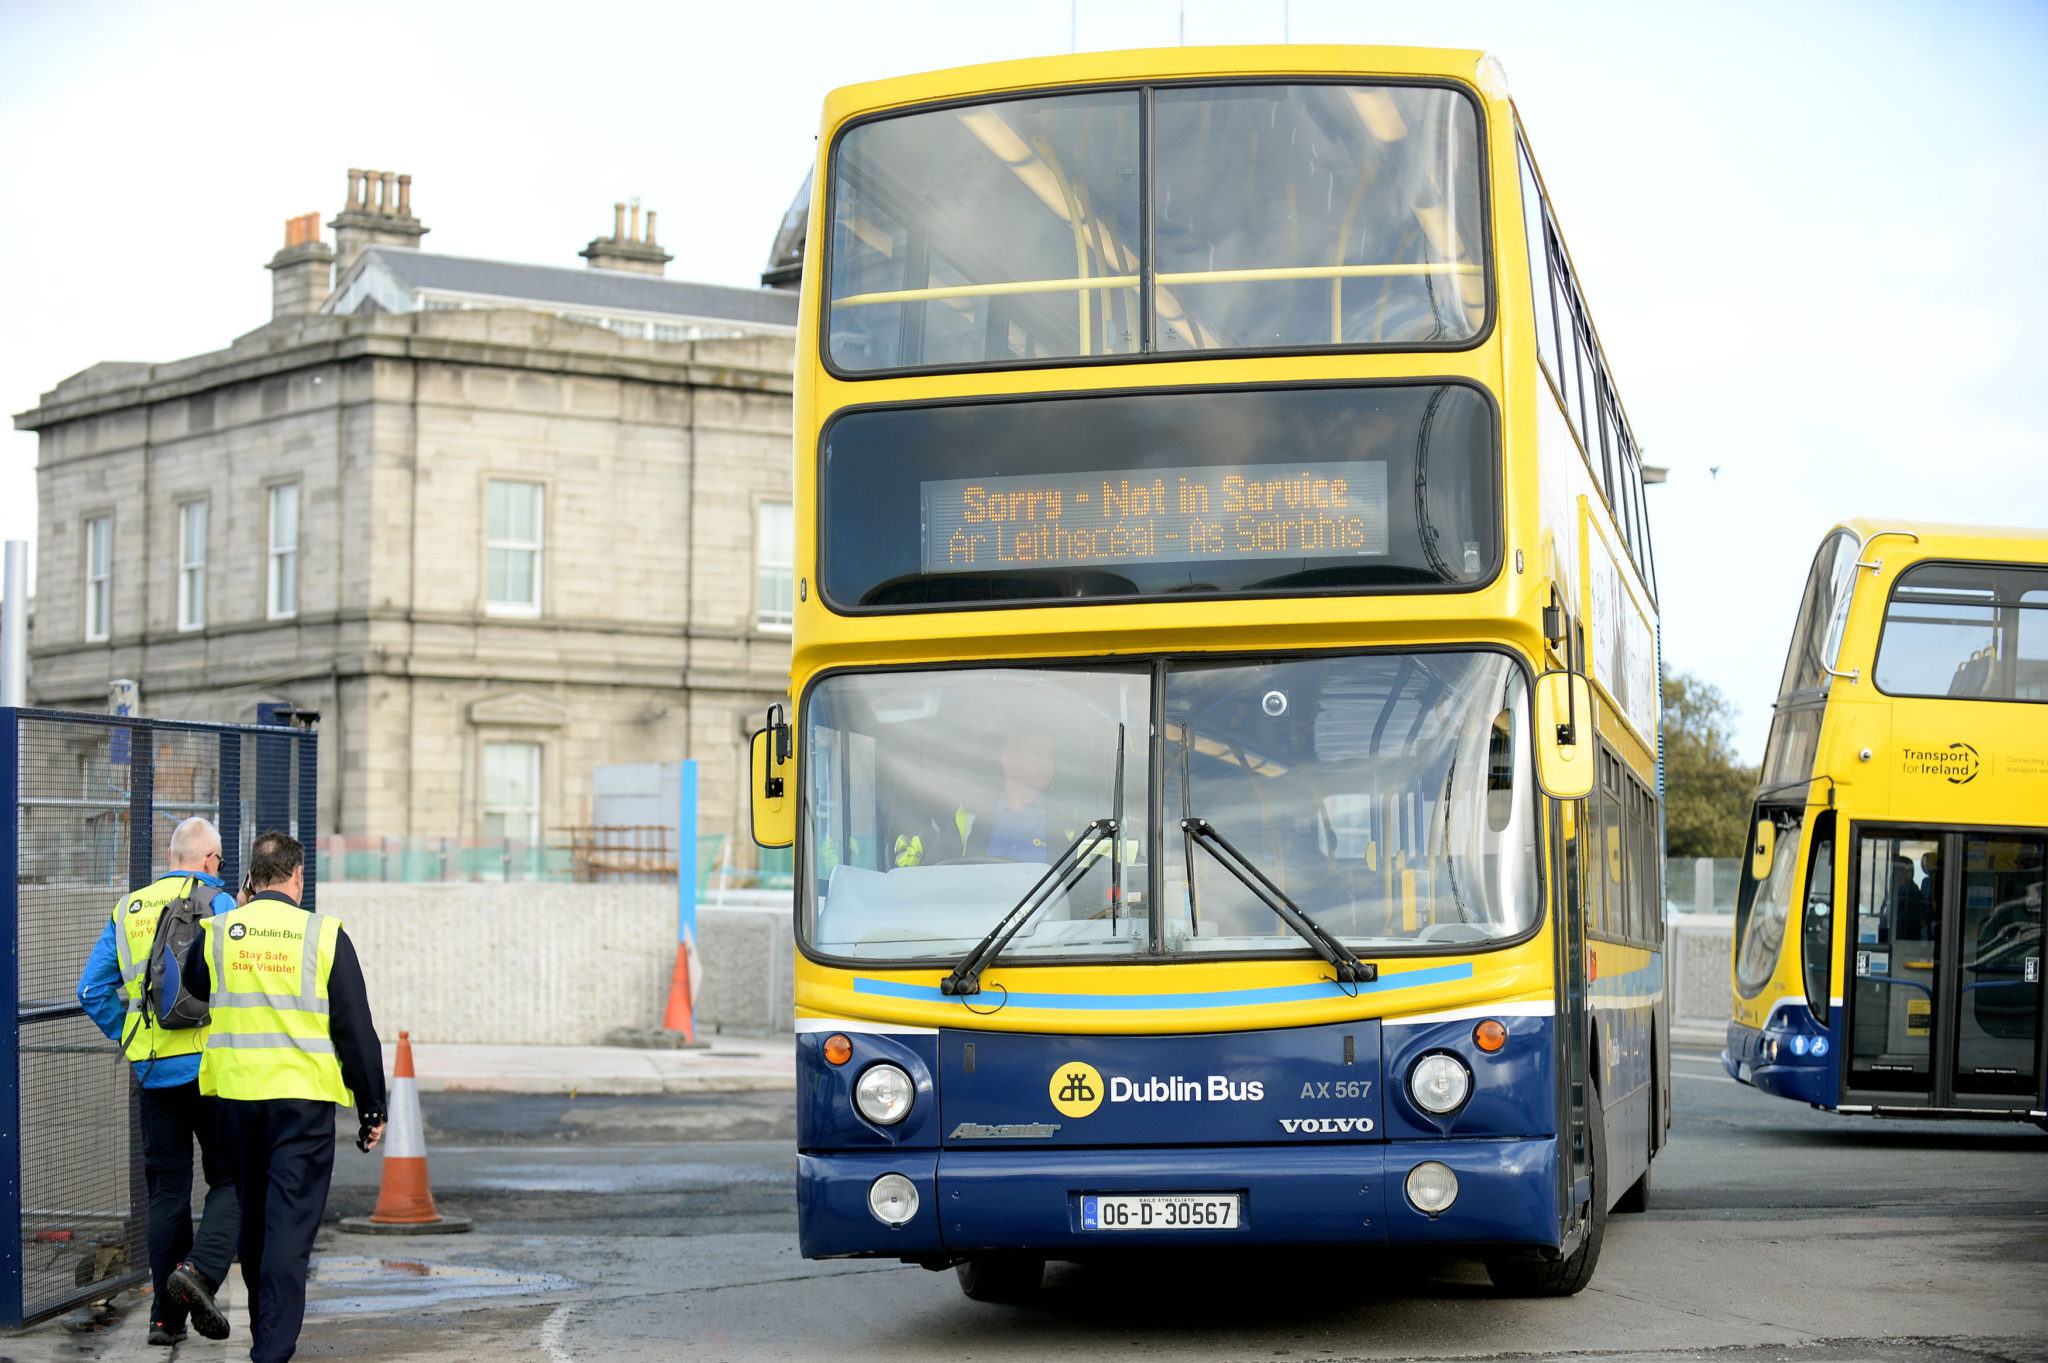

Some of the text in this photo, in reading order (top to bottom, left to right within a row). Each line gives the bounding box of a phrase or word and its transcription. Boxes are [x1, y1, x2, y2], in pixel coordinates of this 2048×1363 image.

[964, 486, 1062, 522] Sorry
[1103, 479, 1165, 517] Not
[1179, 477, 1209, 513] in
[1222, 472, 1347, 512] Service
[950, 527, 986, 563] Ár
[998, 519, 1154, 561] Leithscéal
[1903, 749, 1969, 762] Transport
[1903, 763, 1969, 775] for Ireland
[135, 918, 151, 927] Stay
[130, 930, 144, 939] Stay
[248, 927, 303, 940] Dublin Bus
[239, 950, 288, 961] Stay Safe
[232, 961, 295, 973] Stay Visible!
[1110, 1075, 1264, 1102] Dublin Bus
[1300, 1081, 1372, 1099] AX 567
[948, 1122, 1061, 1139] Alexander
[1279, 1118, 1374, 1133] VOLVO
[1103, 1202, 1231, 1225] 06-D-30567
